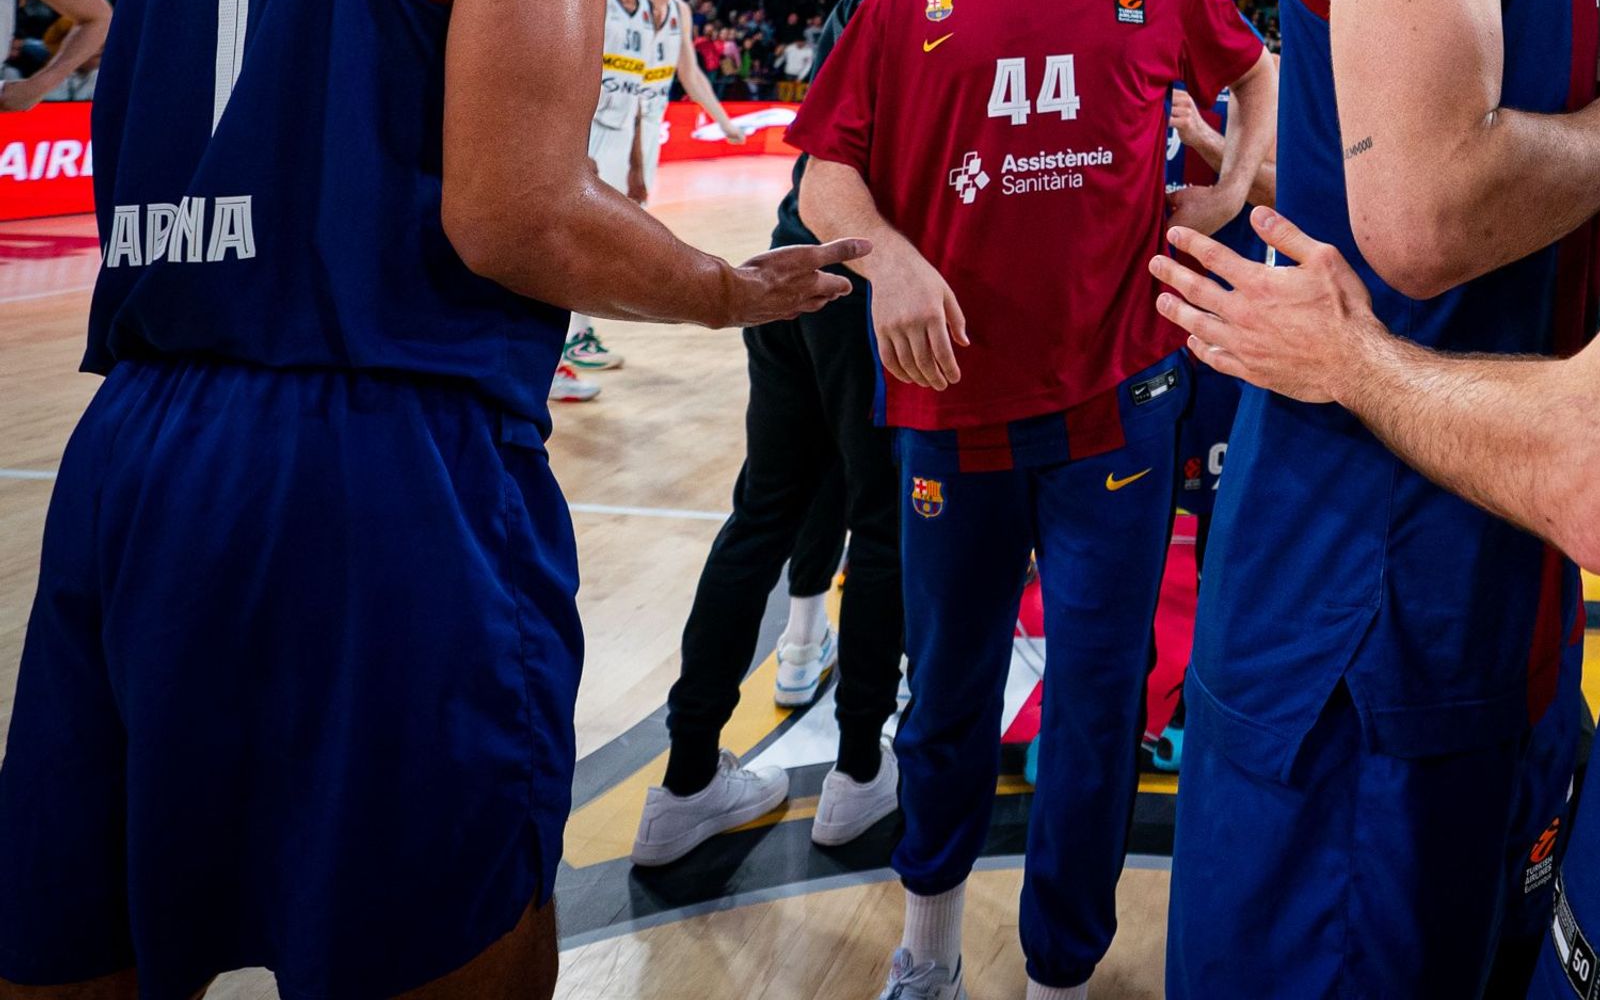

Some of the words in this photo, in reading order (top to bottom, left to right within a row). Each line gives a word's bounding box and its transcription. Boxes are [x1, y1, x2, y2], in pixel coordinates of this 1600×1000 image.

[987, 54, 1081, 125] 44
[1001, 147, 1113, 173] Assistència
[1002, 170, 1084, 195] Sanitària
[1572, 948, 1590, 982] 50
